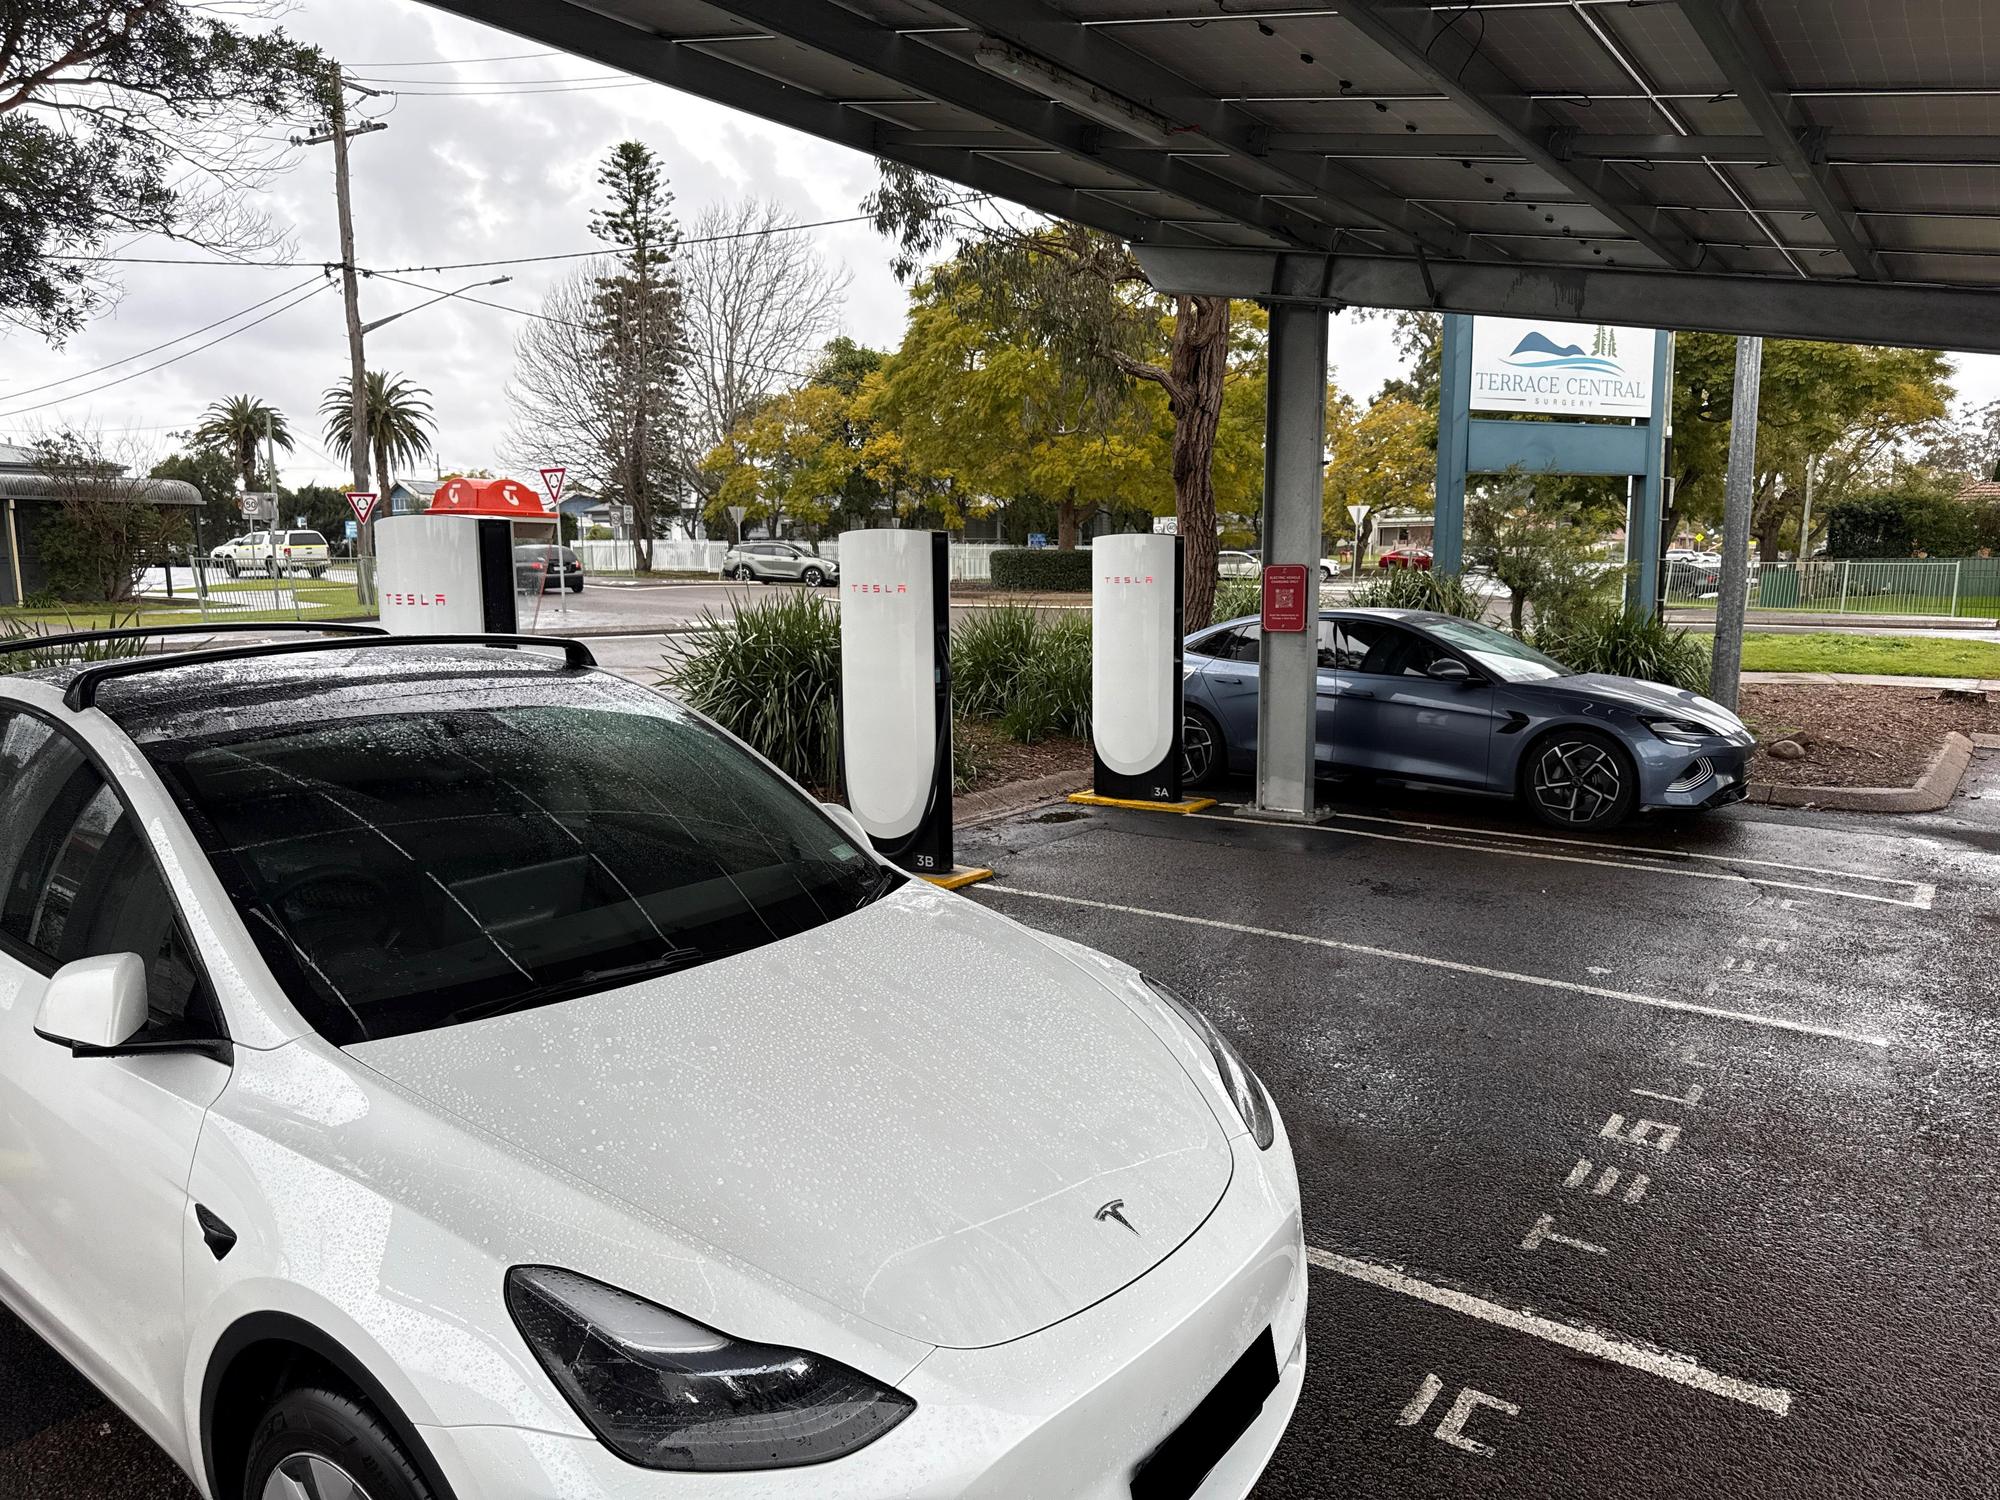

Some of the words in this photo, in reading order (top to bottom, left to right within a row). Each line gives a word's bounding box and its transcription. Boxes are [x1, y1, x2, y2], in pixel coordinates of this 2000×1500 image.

[1475, 372, 1561, 394] TERRACE
[1566, 377, 1646, 399] CENTRAL
[1535, 398, 1593, 408] SURGERY
[1104, 576, 1153, 584] TESLA
[851, 584, 906, 593] TESLA
[386, 593, 446, 606] TESLA
[1154, 787, 1169, 797] 3A
[916, 855, 934, 867] 3B
